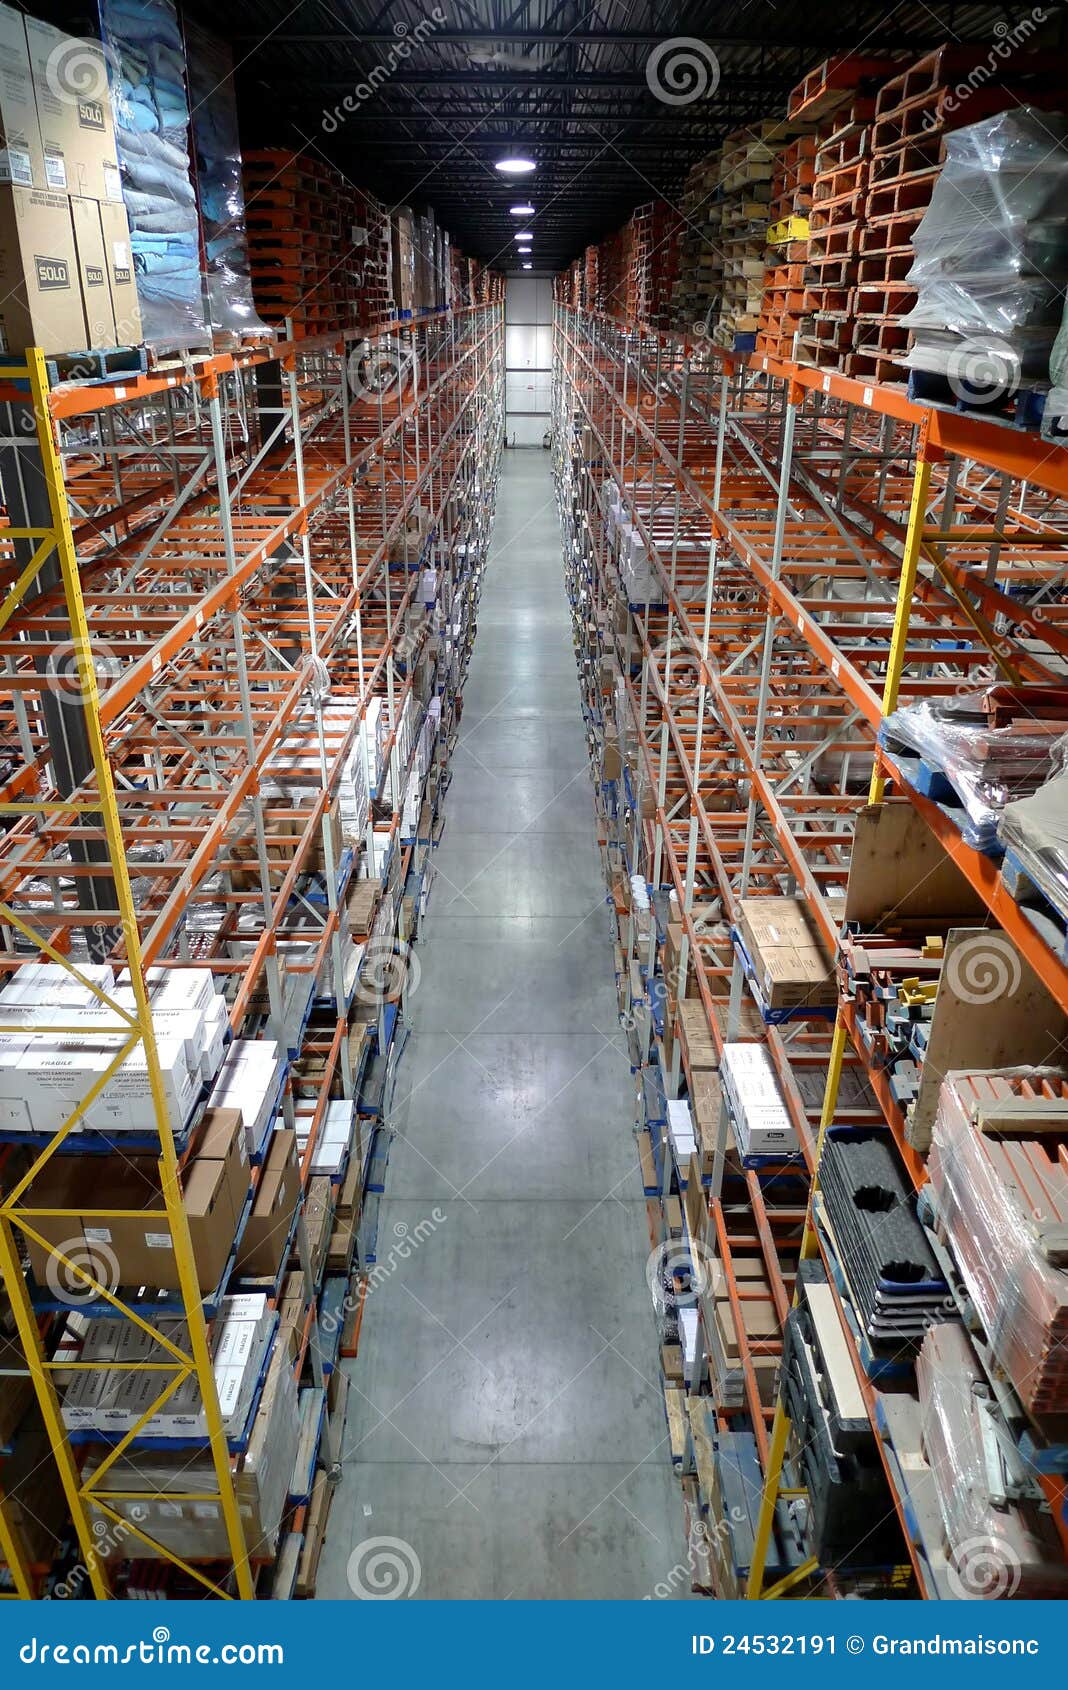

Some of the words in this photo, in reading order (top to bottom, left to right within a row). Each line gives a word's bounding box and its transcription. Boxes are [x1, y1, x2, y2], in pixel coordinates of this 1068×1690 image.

[80, 105, 103, 124] SOLO
[39, 266, 66, 281] SOLO
[87, 271, 103, 281] SOLO
[115, 271, 129, 280] SOLO
